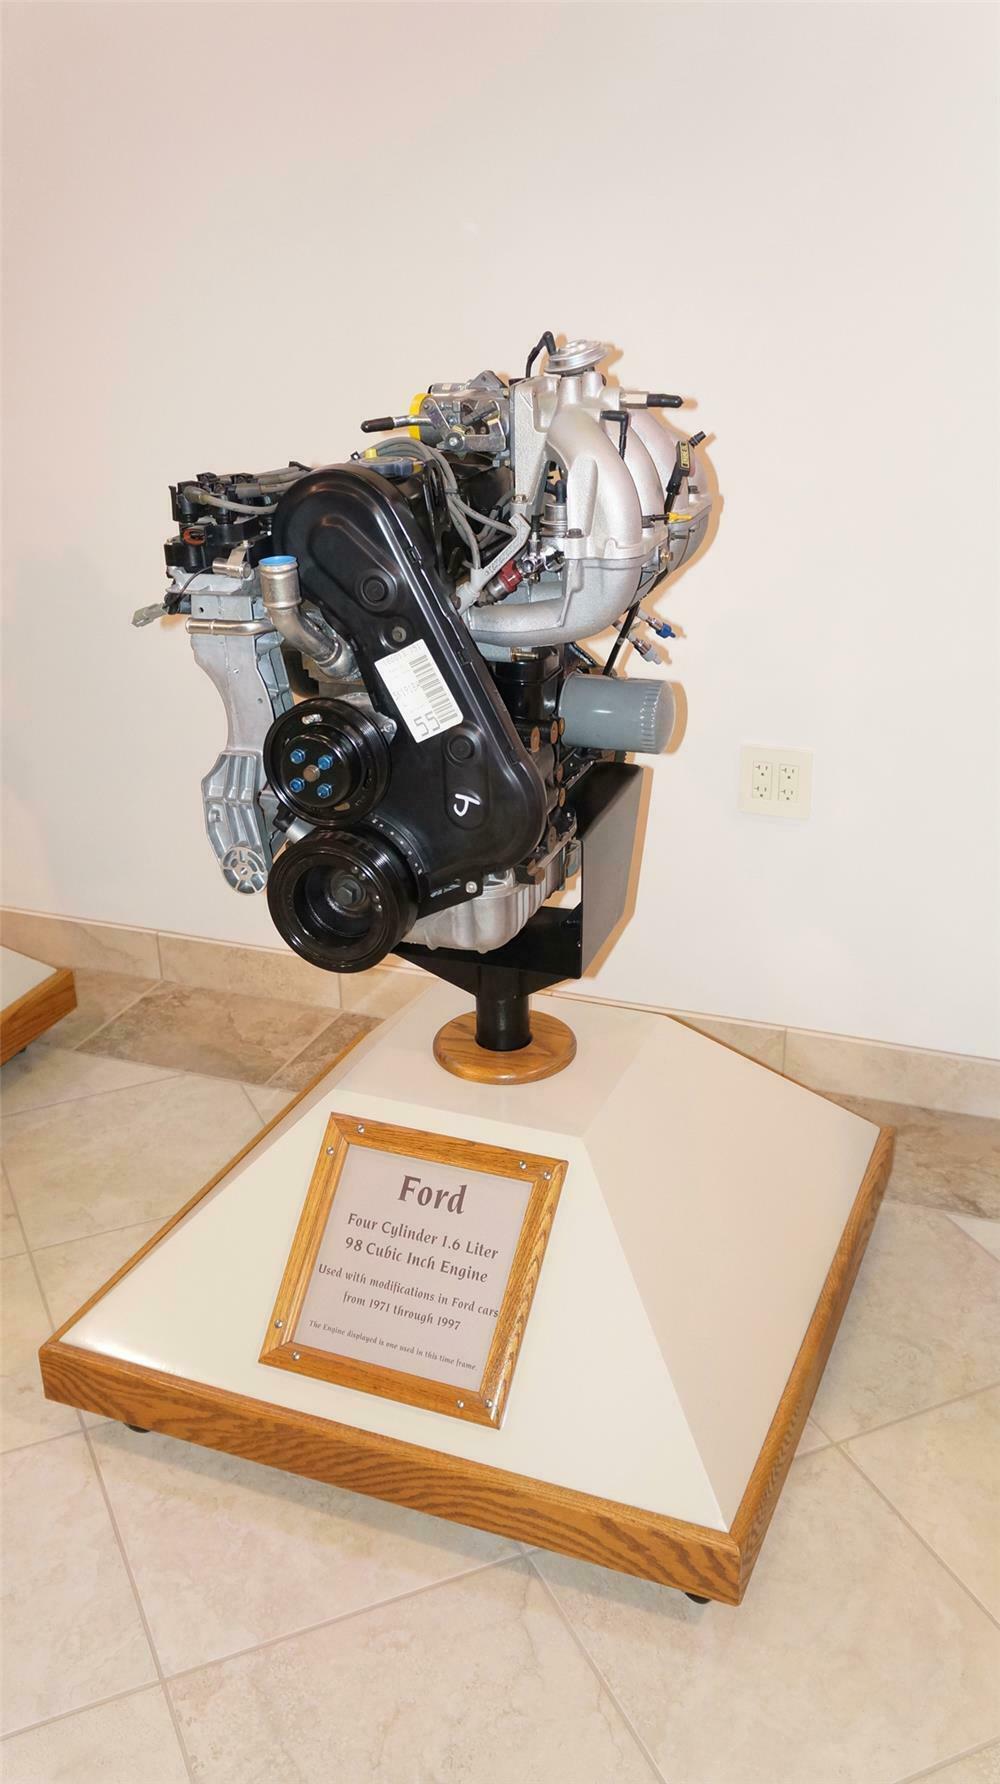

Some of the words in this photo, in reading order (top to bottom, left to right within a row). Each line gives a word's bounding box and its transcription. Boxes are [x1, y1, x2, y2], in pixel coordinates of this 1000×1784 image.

[413, 711, 441, 736] 55
[398, 1175, 467, 1214] Ford
[348, 1213, 378, 1230] Four
[381, 1221, 438, 1245] Cylinder
[442, 1235, 461, 1251] 1.6
[466, 1241, 499, 1260] Liter
[345, 1237, 363, 1252] 98
[366, 1242, 402, 1263] Cubic
[406, 1252, 436, 1271] Inch
[440, 1260, 488, 1283] Engine
[318, 1263, 343, 1278] Used
[345, 1271, 367, 1285] with
[369, 1278, 435, 1302] modifications
[438, 1293, 448, 1305] in
[451, 1297, 475, 1312] Ford
[477, 1305, 499, 1318] cars
[343, 1291, 366, 1306] from
[369, 1298, 391, 1313] 1971
[393, 1305, 433, 1325] through
[437, 1316, 461, 1331] 1997
[309, 1320, 321, 1329] The
[322, 1323, 345, 1336] Engine
[347, 1330, 378, 1345] displayed
[386, 1342, 398, 1350] one
[400, 1345, 415, 1354] used
[416, 1347, 423, 1357] in
[425, 1350, 438, 1360] this
[439, 1355, 454, 1365] time
